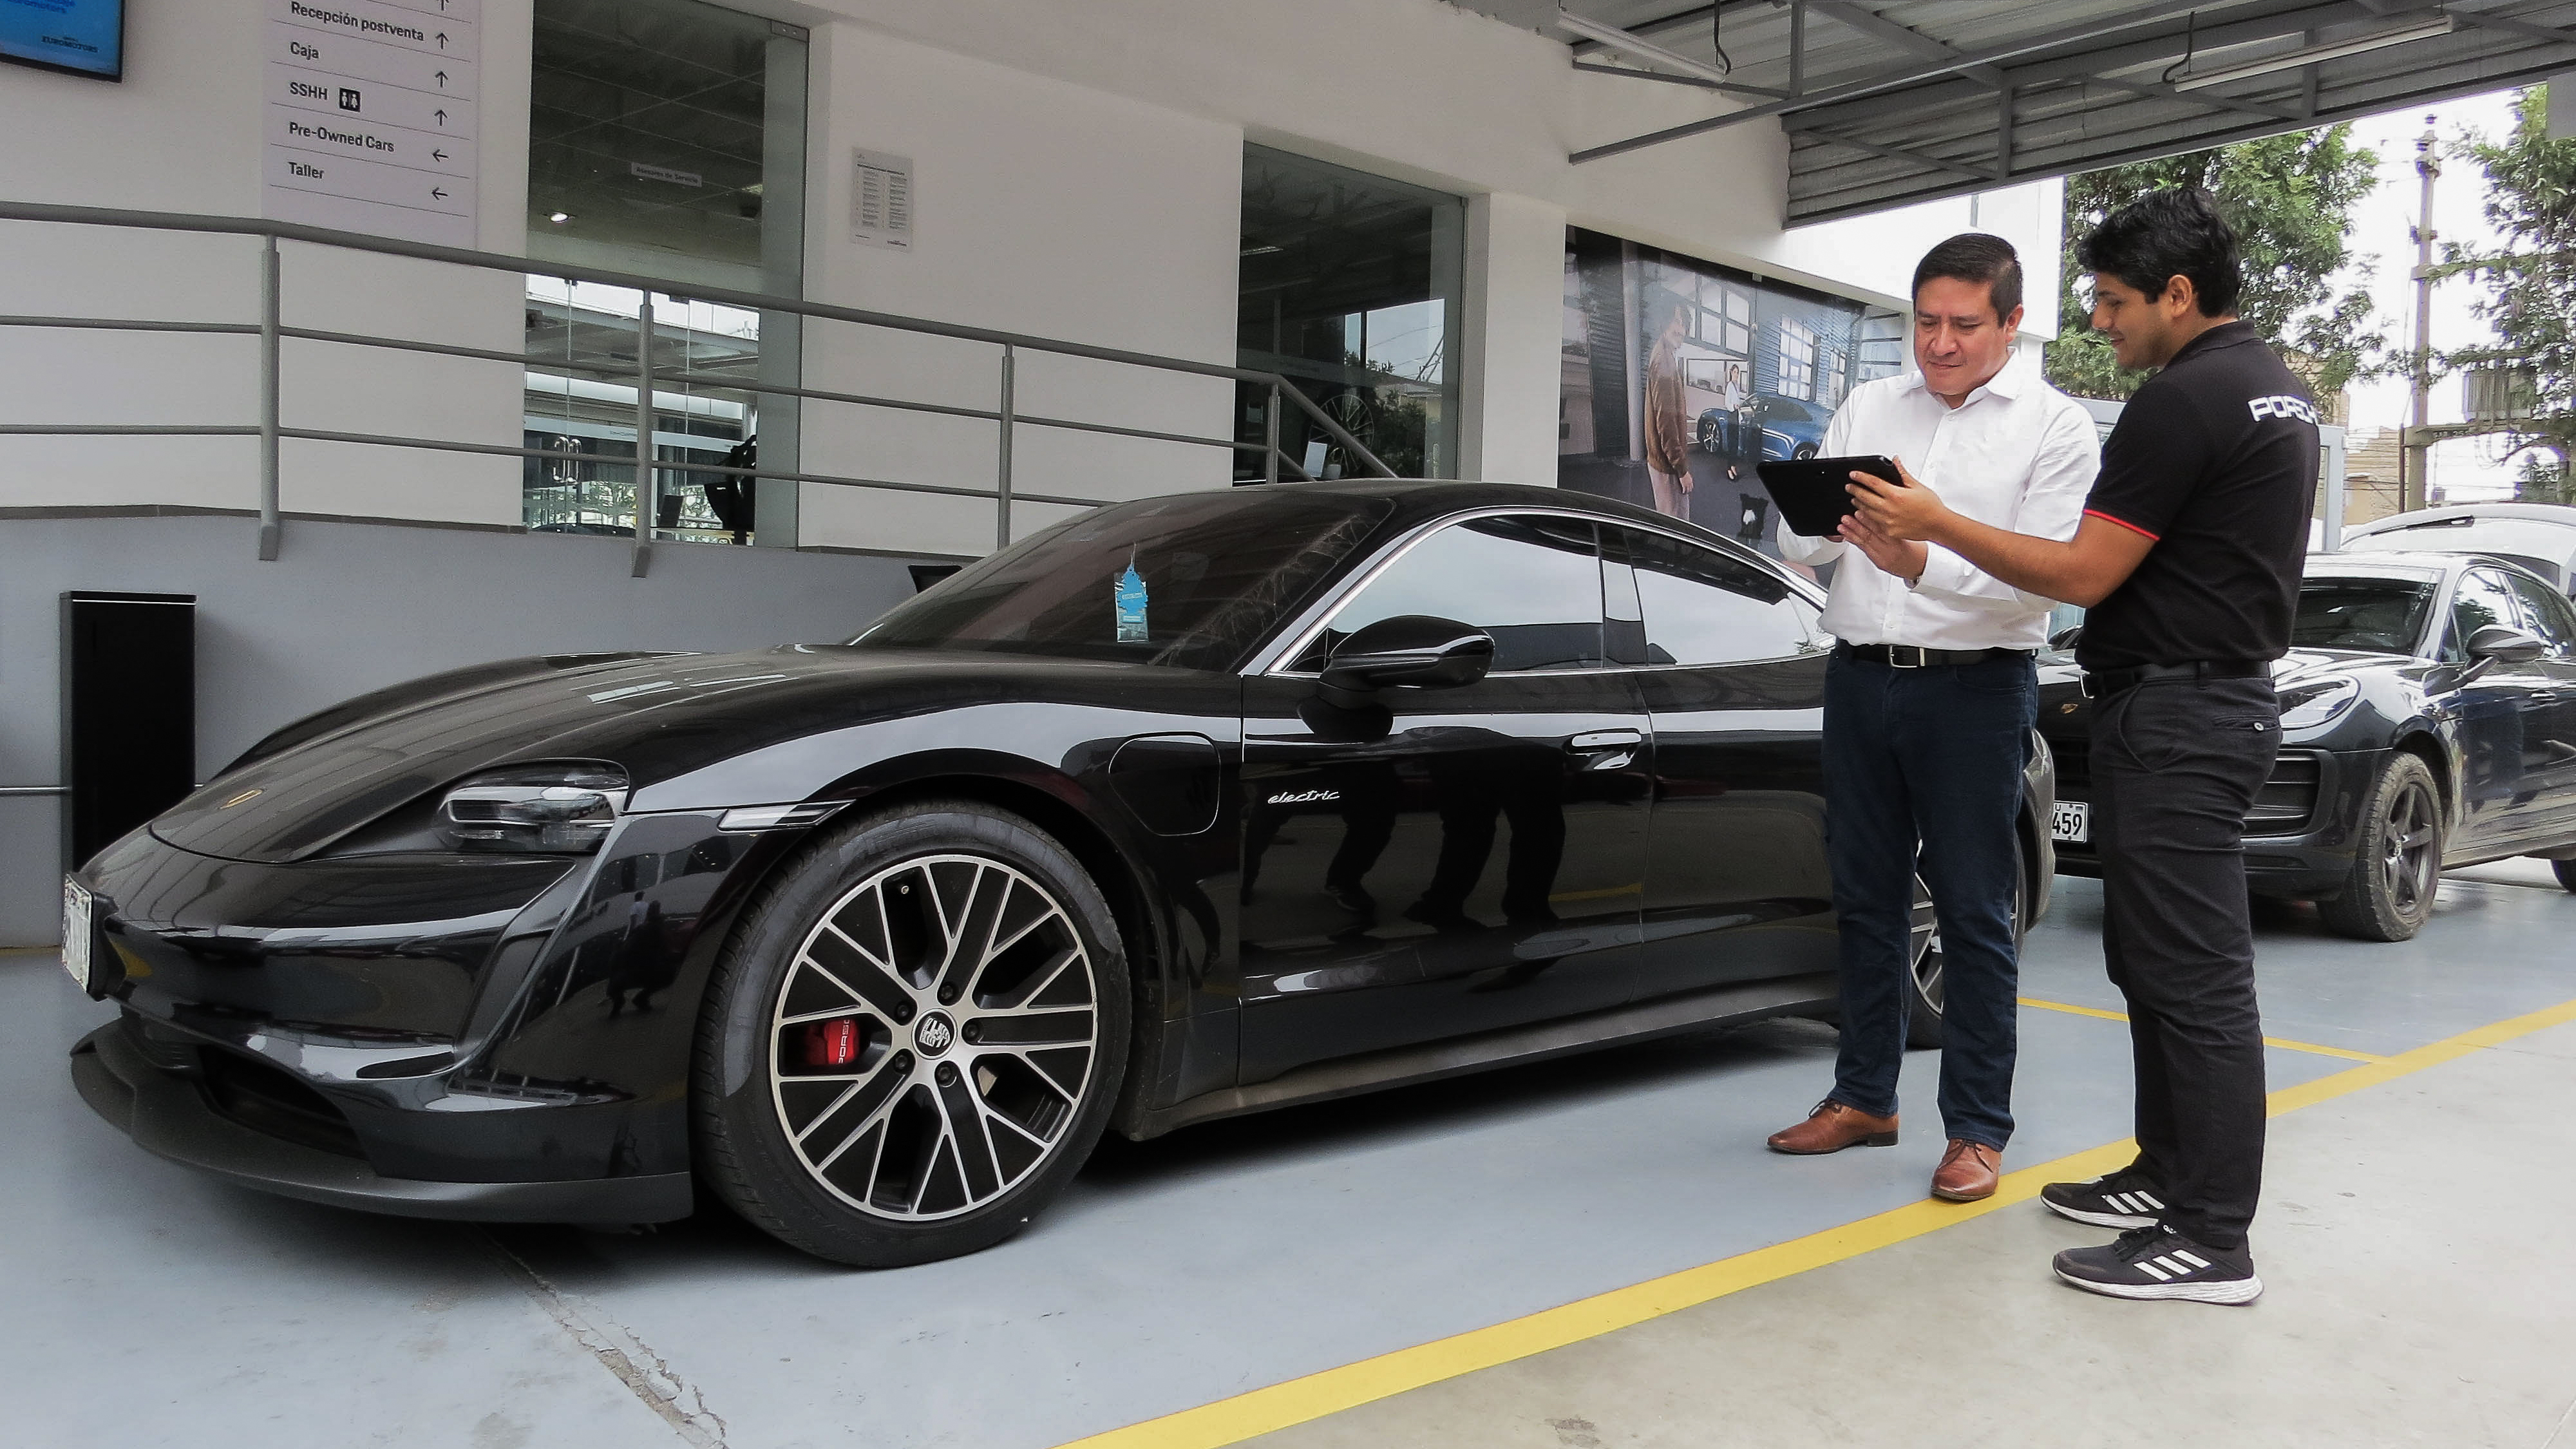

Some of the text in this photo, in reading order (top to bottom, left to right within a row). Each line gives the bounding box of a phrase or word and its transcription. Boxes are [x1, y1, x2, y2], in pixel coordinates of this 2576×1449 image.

[291, 1, 424, 41] Recepción postventa
[290, 42, 319, 61] Caja
[290, 82, 328, 100] SSHH
[290, 121, 395, 153] Pre-Owned Cars
[289, 162, 324, 179] Taller
[1267, 790, 1340, 804] electric
[2052, 812, 2082, 835] 459
